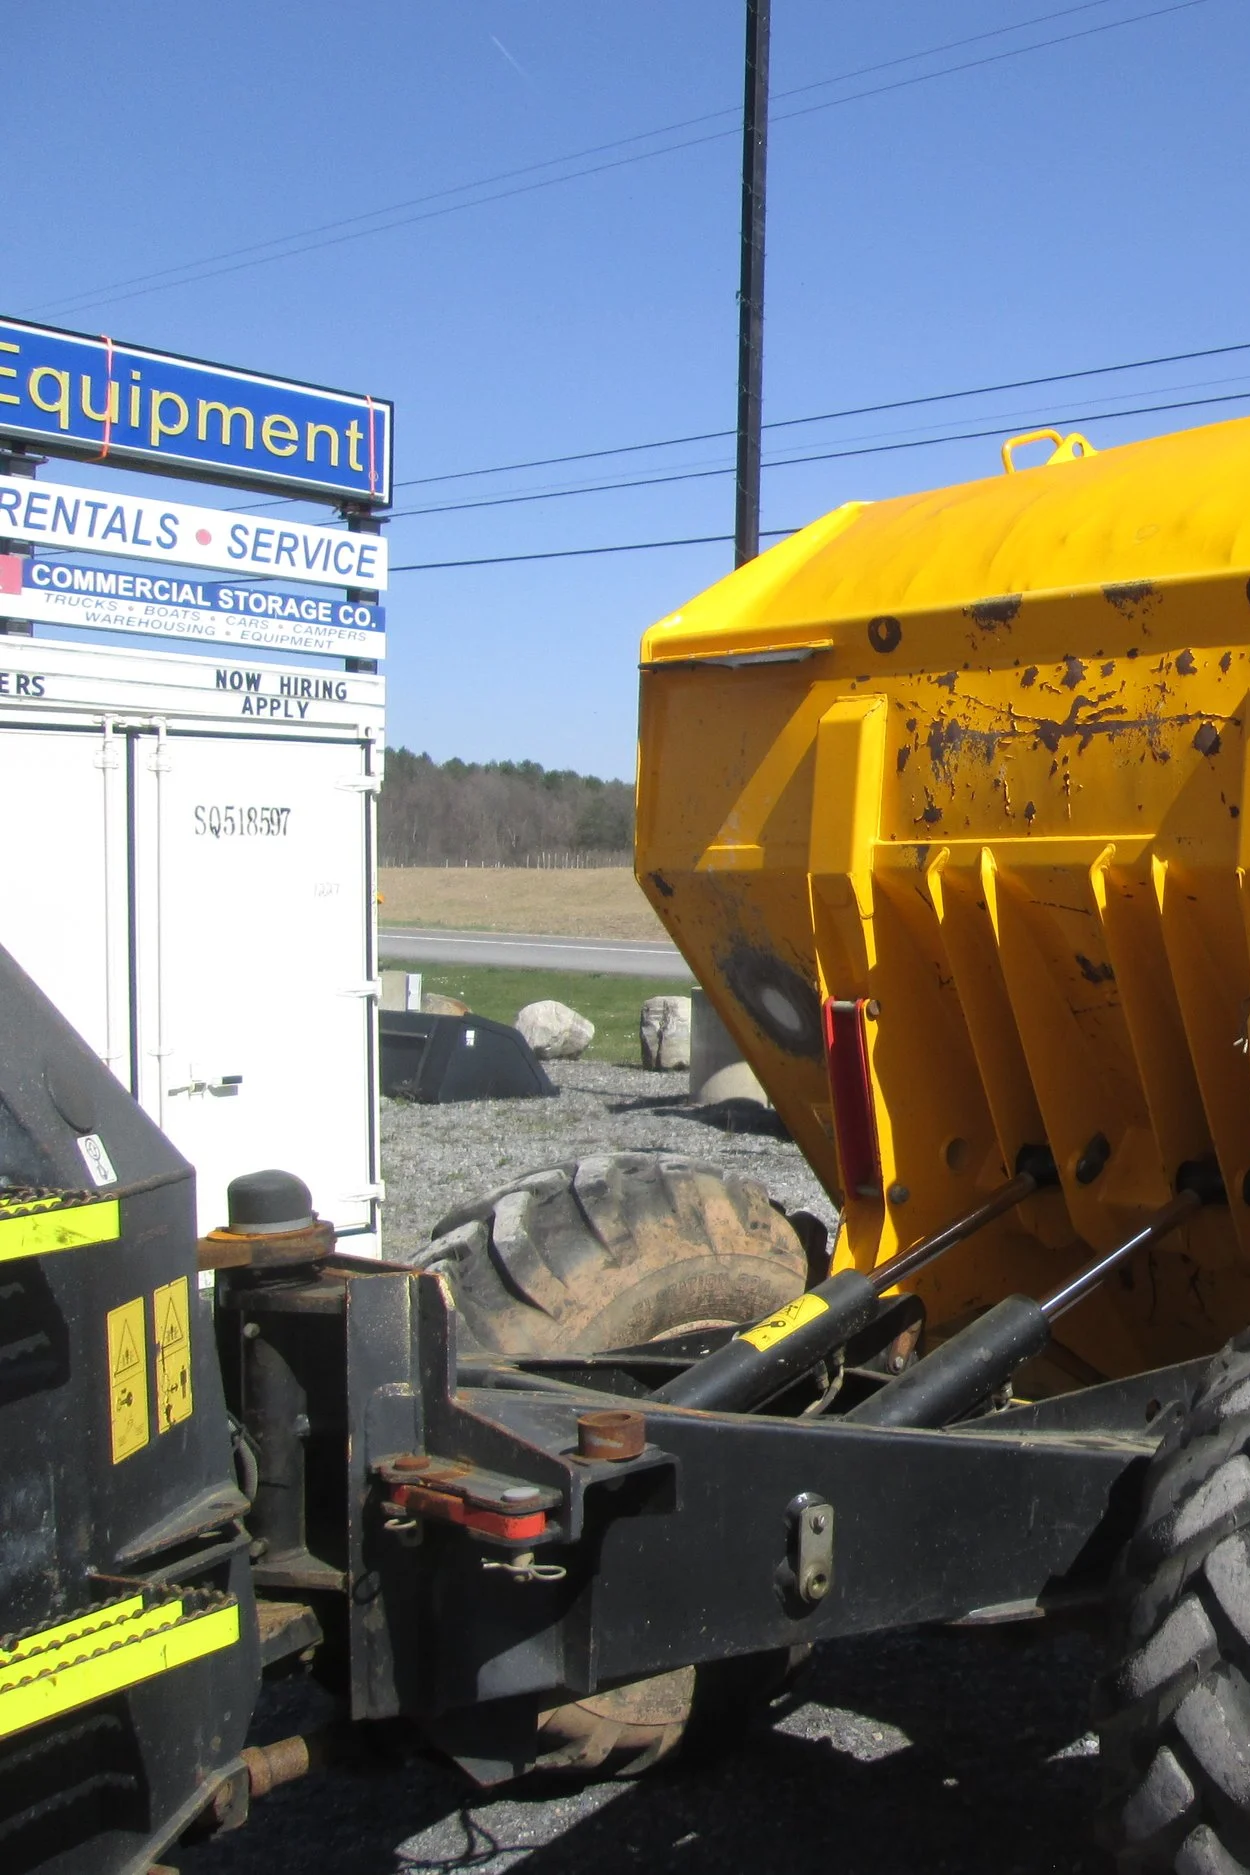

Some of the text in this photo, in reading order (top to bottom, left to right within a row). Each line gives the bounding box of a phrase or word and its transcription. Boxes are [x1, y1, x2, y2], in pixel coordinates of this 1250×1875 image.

[0, 342, 364, 472] Equipment
[0, 488, 378, 578] RENTALS SERVICE
[32, 563, 376, 628] COMMERCIAL STORAGE CO.
[44, 592, 367, 642] TRUCKS BOATS CARS CAMPERS
[85, 611, 335, 649] WAREHOUSING EQUIPMENT
[215, 668, 348, 701] NOW HIRING
[241, 695, 310, 718] APPLY
[194, 804, 292, 840] SQ518597
